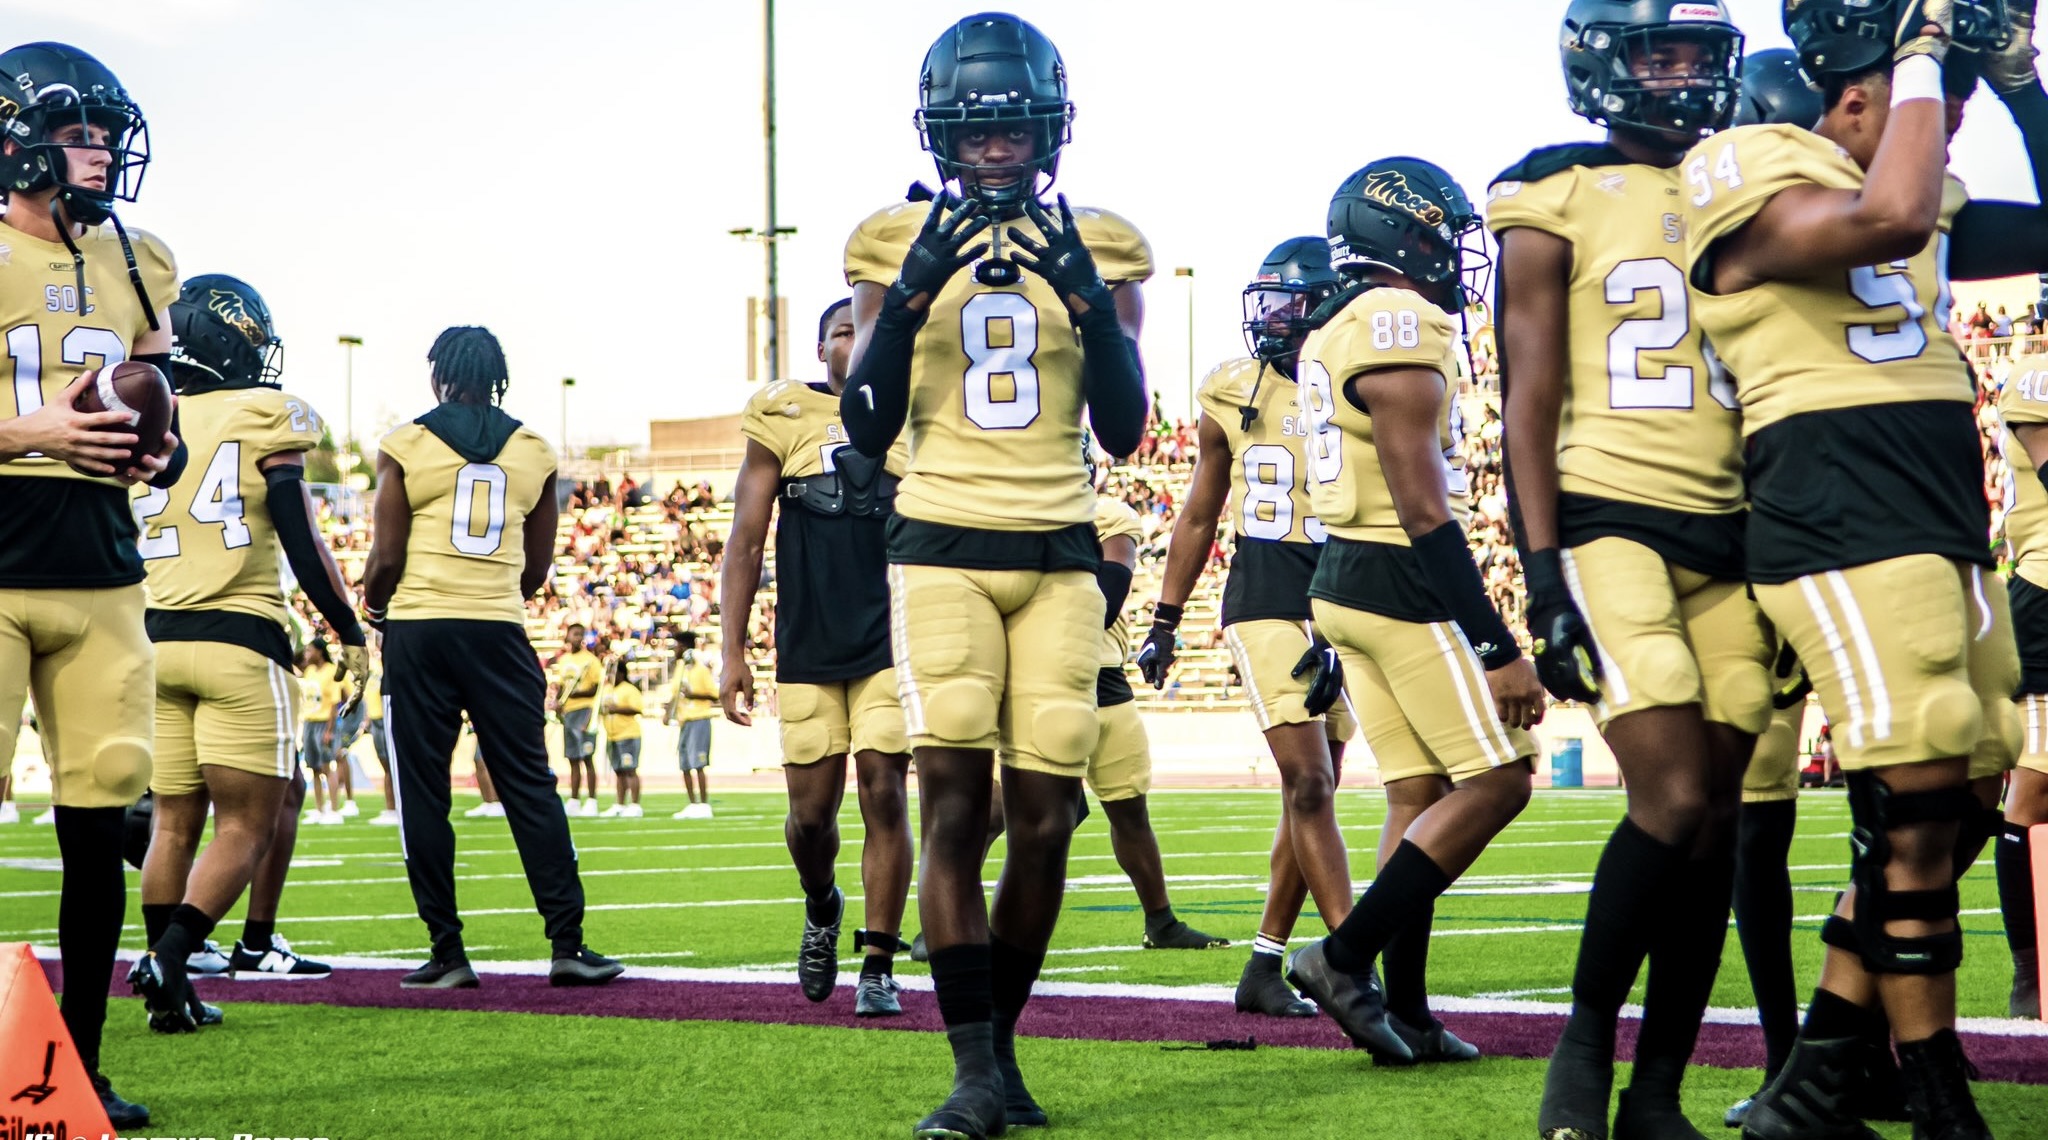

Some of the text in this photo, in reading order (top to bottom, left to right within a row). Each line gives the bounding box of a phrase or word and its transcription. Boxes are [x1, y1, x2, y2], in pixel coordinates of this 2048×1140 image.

[1365, 170, 1444, 227] Mecca
[1686, 142, 1743, 208] 54
[960, 291, 1041, 430] 8
[1371, 309, 1420, 350] 88
[1604, 257, 1743, 412] 2
[286, 401, 319, 432] 24
[2015, 369, 2048, 402] 40
[1298, 359, 1343, 484] 8
[450, 462, 507, 556] 0
